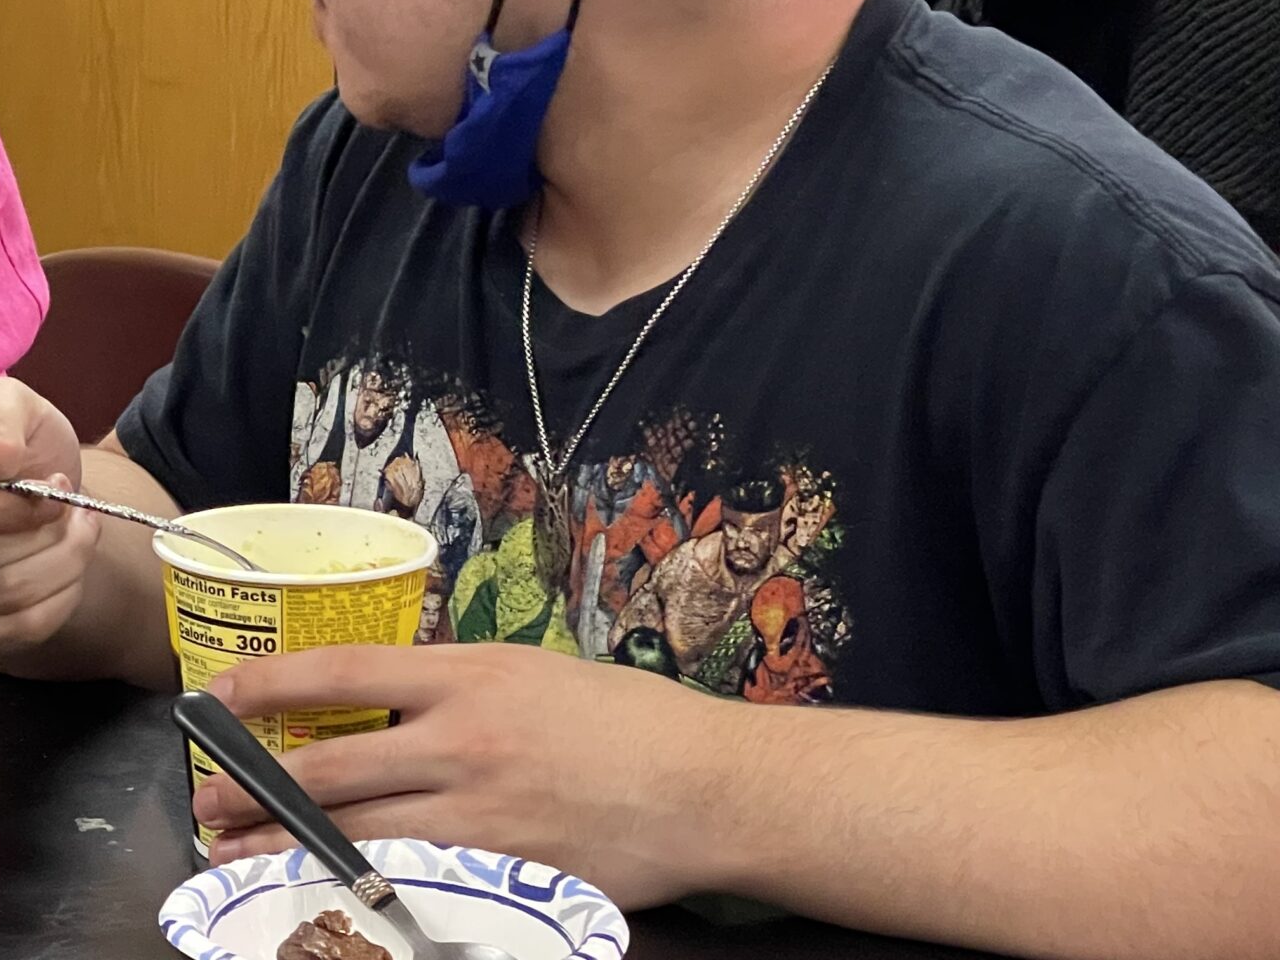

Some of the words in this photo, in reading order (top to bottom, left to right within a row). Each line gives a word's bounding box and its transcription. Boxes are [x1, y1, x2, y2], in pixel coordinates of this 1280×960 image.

[173, 570, 226, 598] Nutrition
[231, 586, 277, 603] Facts
[220, 611, 252, 624] package
[254, 615, 277, 626] (74g)
[178, 621, 224, 647] Calories
[235, 635, 277, 653] 300
